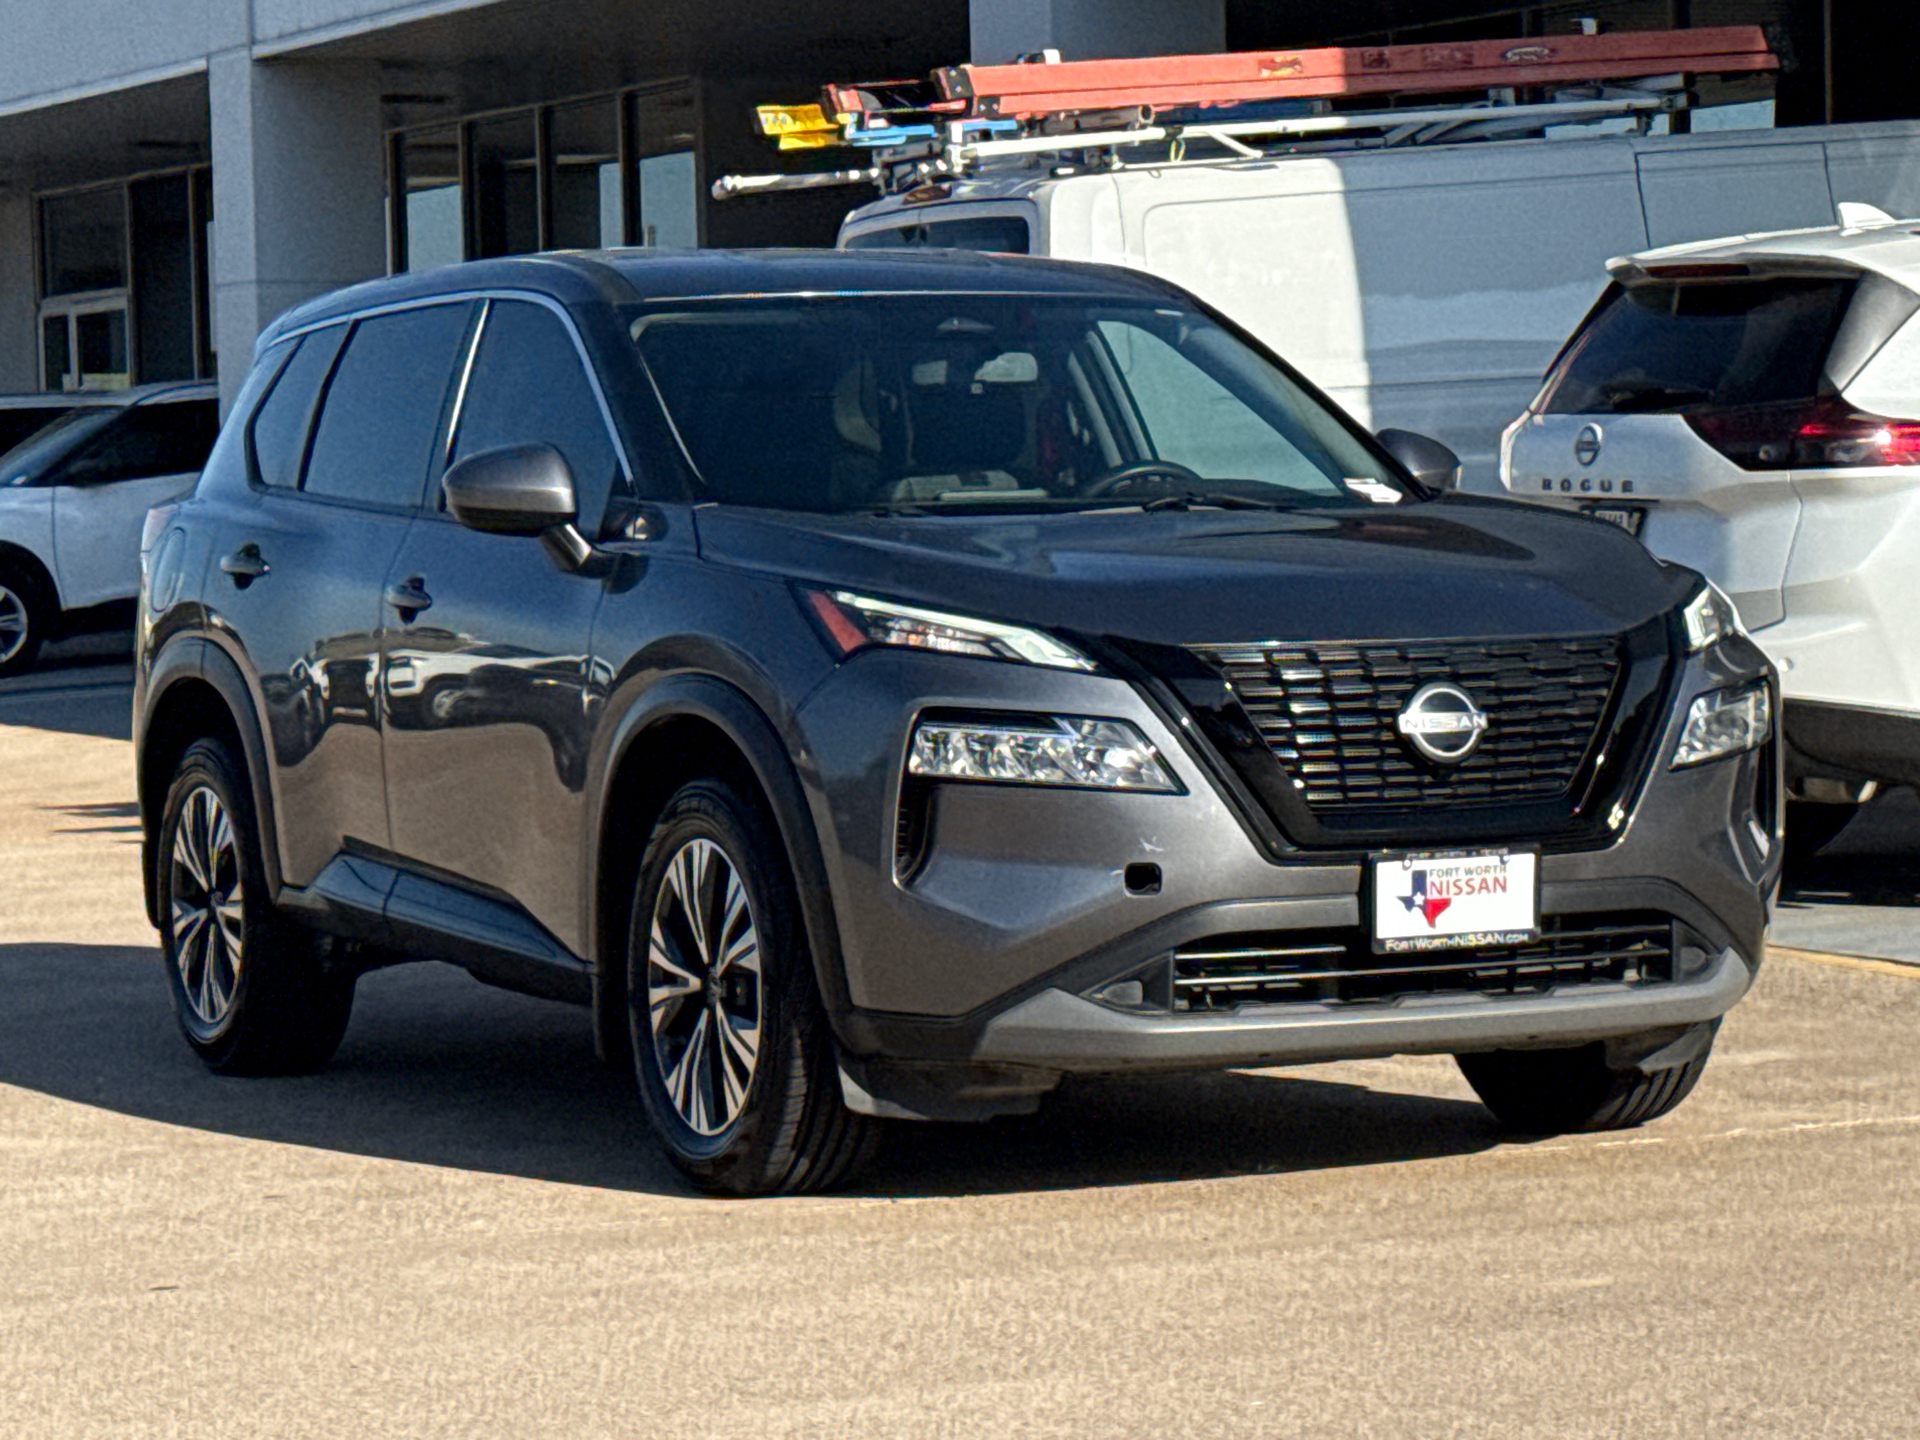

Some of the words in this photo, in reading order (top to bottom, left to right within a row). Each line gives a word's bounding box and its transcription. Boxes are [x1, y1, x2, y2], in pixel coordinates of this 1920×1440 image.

[1541, 478, 1634, 493] ROGUE
[1404, 714, 1488, 730] NISSAN
[1429, 866, 1461, 879] FORT
[1464, 864, 1507, 877] WORTH
[1429, 875, 1508, 897] NISSAN
